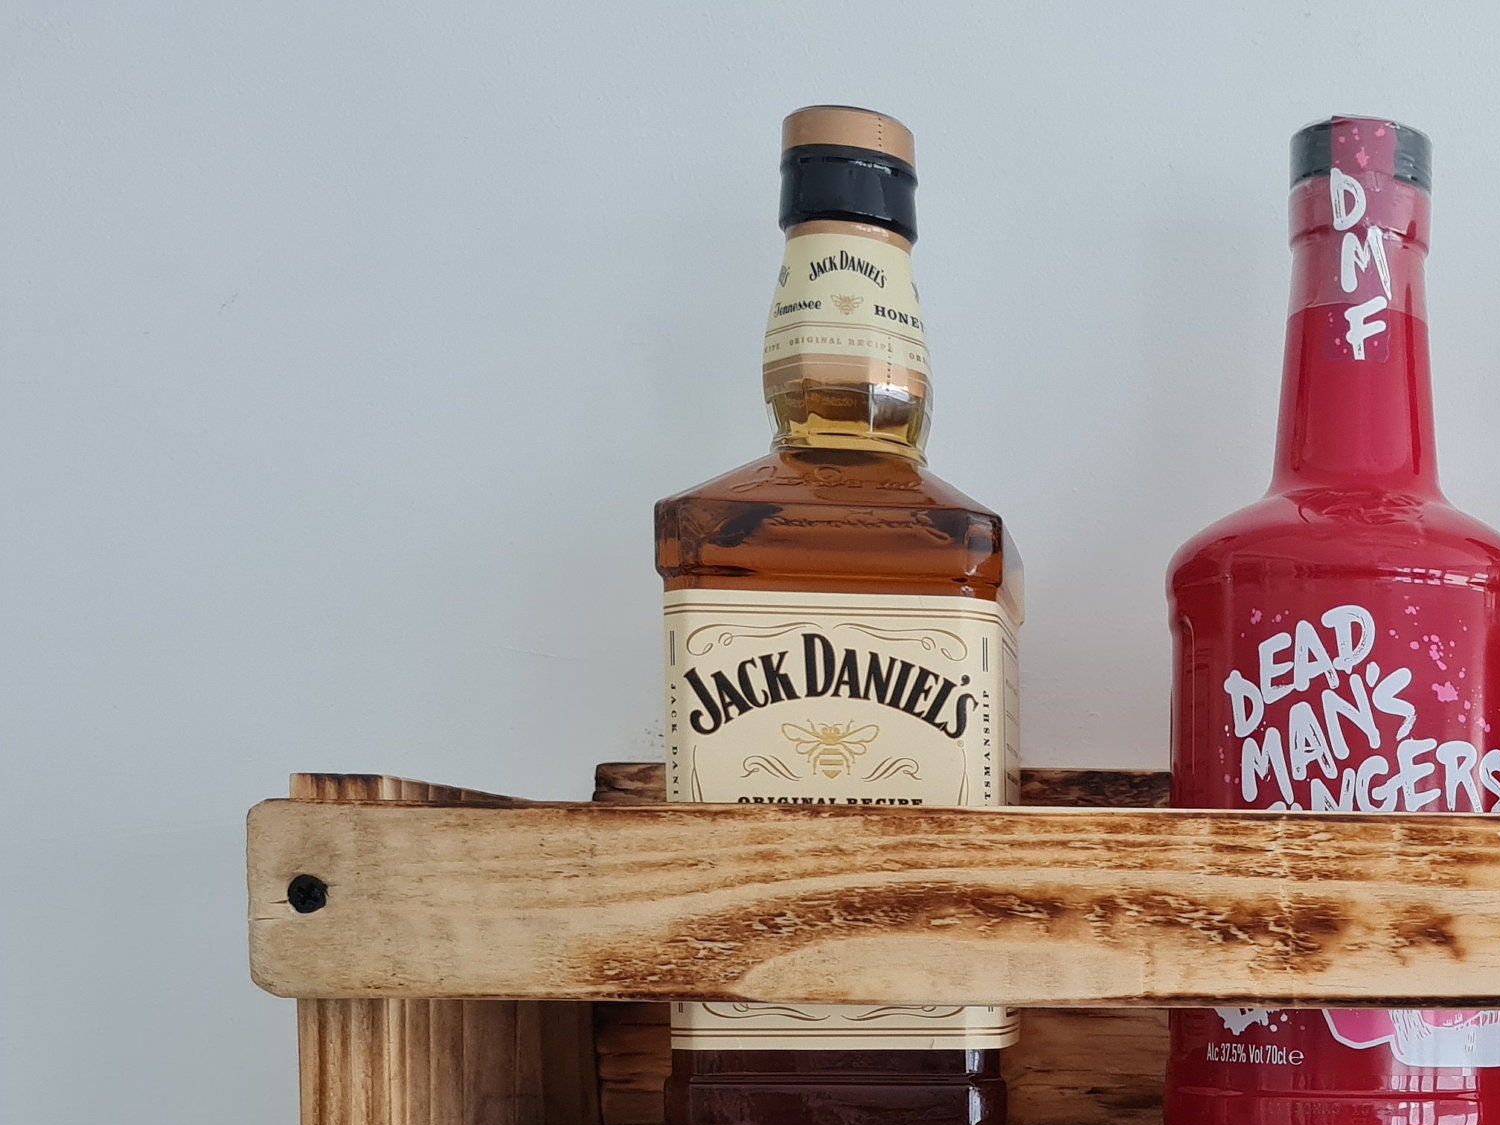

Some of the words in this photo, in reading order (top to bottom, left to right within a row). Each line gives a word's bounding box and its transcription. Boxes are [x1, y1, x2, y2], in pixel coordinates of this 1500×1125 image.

[809, 255, 838, 281] JACK
[774, 300, 822, 318] Tennessee
[789, 336, 842, 346] ORIGINAL
[683, 650, 801, 736] JACK
[801, 632, 979, 740] DANIEL'S
[1224, 604, 1376, 738] DEAD
[670, 683, 678, 733] JACK
[1241, 661, 1417, 804] MAN'S
[983, 690, 991, 806] TSMANSHIP
[1206, 1042, 1219, 1061] Alc
[1220, 1042, 1246, 1063] 37.5%
[1248, 1044, 1264, 1064] Vol
